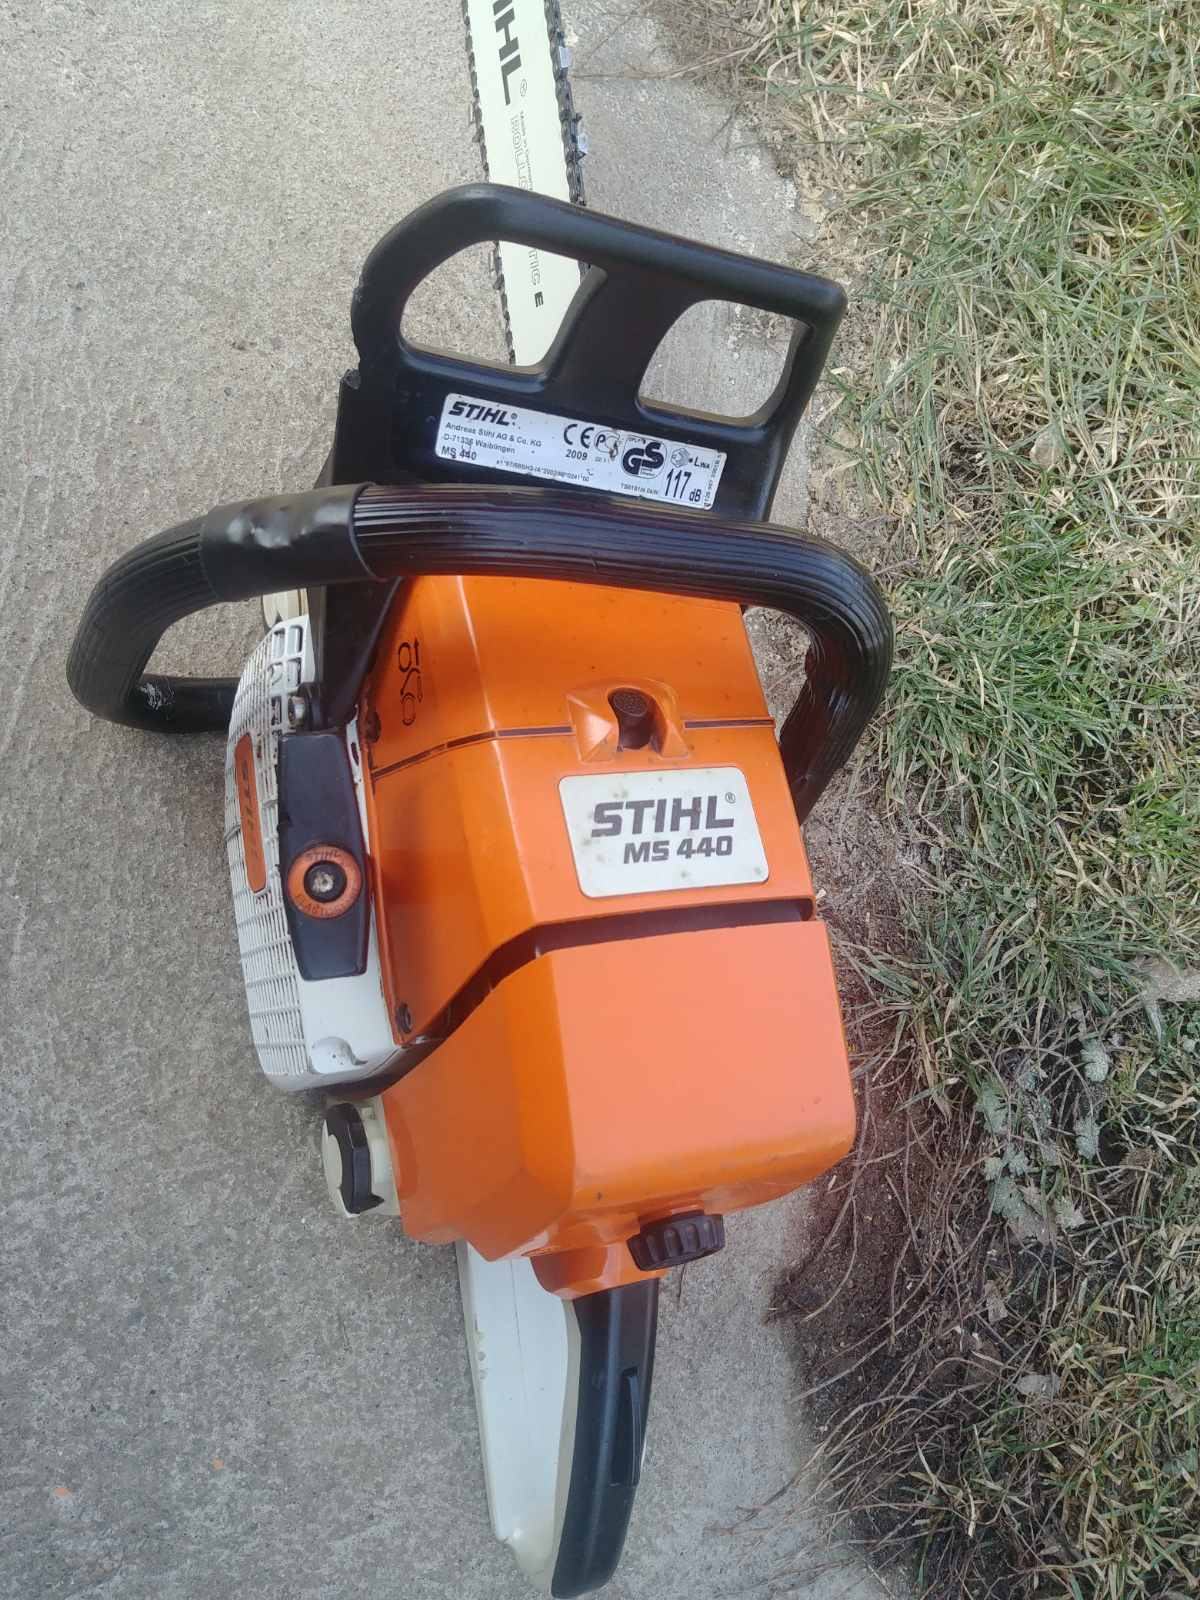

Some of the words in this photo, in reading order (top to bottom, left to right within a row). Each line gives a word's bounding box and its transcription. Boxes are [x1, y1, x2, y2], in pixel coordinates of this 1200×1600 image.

[448, 401, 510, 426] STIHL
[496, 432, 508, 441] AG
[530, 439, 542, 447] KG
[565, 448, 588, 461] 2009
[622, 441, 664, 475] GS
[664, 468, 692, 499] 117
[689, 488, 702, 502] dB
[591, 796, 734, 837] STIHL
[624, 841, 669, 864] MS
[676, 835, 733, 860] 440
